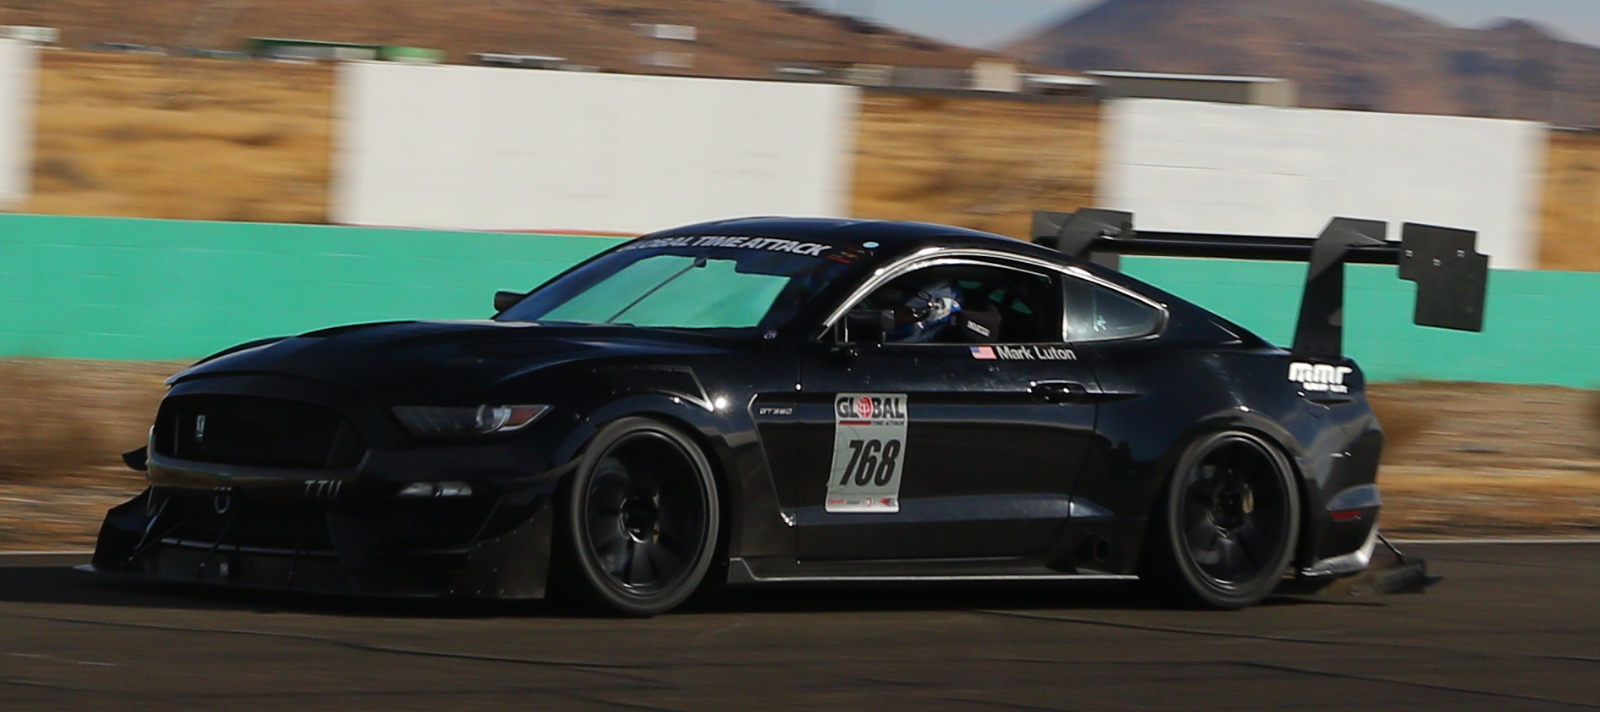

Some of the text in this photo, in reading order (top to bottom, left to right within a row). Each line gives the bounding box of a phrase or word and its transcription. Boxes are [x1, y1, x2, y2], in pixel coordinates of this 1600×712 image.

[691, 236, 750, 247] TIME
[738, 237, 833, 257] ATTACK
[995, 345, 1077, 361] Mark Luton
[836, 395, 905, 419] GLOBAL
[839, 438, 901, 487] 768
